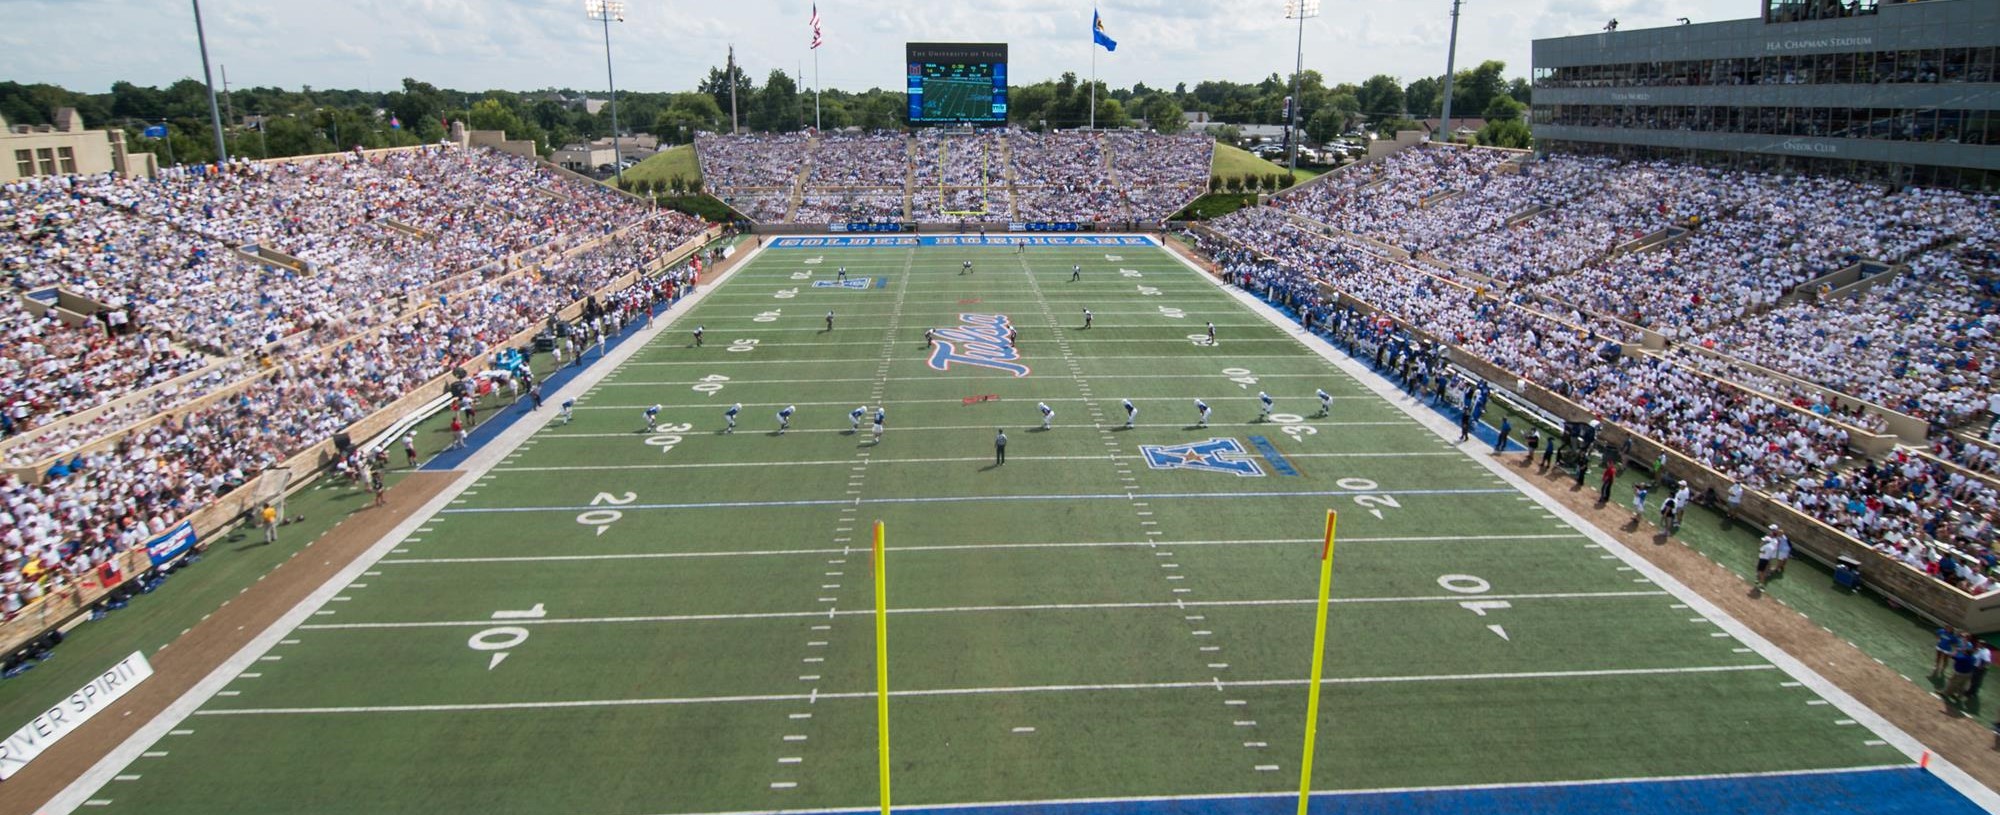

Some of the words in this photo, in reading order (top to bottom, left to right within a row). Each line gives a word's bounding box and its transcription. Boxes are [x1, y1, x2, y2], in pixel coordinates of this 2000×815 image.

[1784, 39, 1828, 50] CHAPMAN
[1830, 36, 1872, 47] STADIUM
[778, 237, 918, 247] GOLDEN
[935, 236, 1147, 246] HURRICANE
[727, 338, 760, 352] 50
[927, 312, 1032, 378] Tulsa
[691, 373, 731, 392] 40
[1222, 367, 1260, 385] 40
[644, 422, 693, 446] 30
[1268, 413, 1318, 435] 30
[1336, 477, 1402, 508] 20
[576, 491, 638, 525] 20
[1436, 573, 1513, 617] 10
[468, 602, 548, 651] 10
[0, 706, 69, 769] RIVER
[70, 659, 136, 714] SPIRIT
